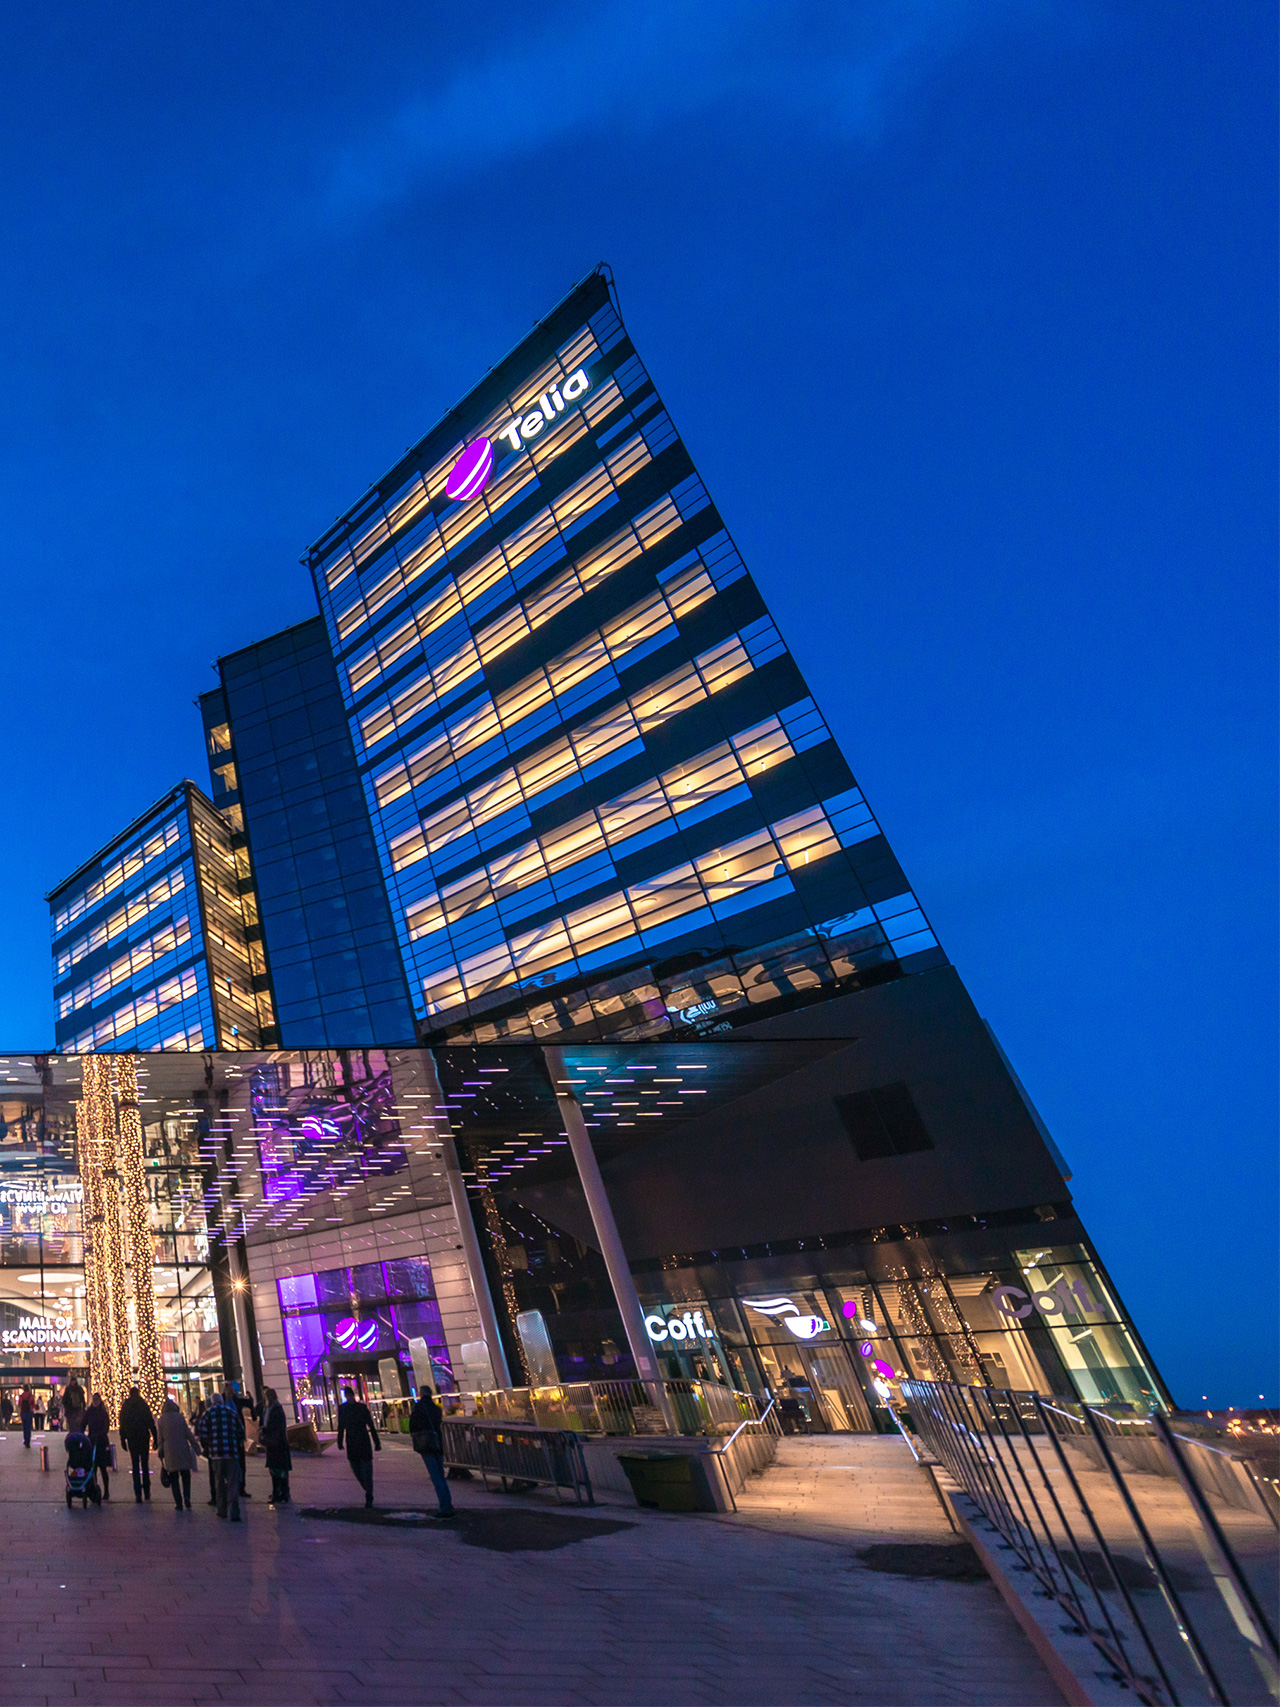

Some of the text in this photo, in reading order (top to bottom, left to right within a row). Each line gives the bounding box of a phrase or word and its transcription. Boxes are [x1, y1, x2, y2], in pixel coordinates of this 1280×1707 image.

[499, 368, 589, 450] Telia
[992, 1278, 1105, 1319] Coff.
[1, 1329, 93, 1343] SCANDINAVIA
[19, 1316, 73, 1330] MALL OF
[645, 1311, 714, 1342] Coff.
